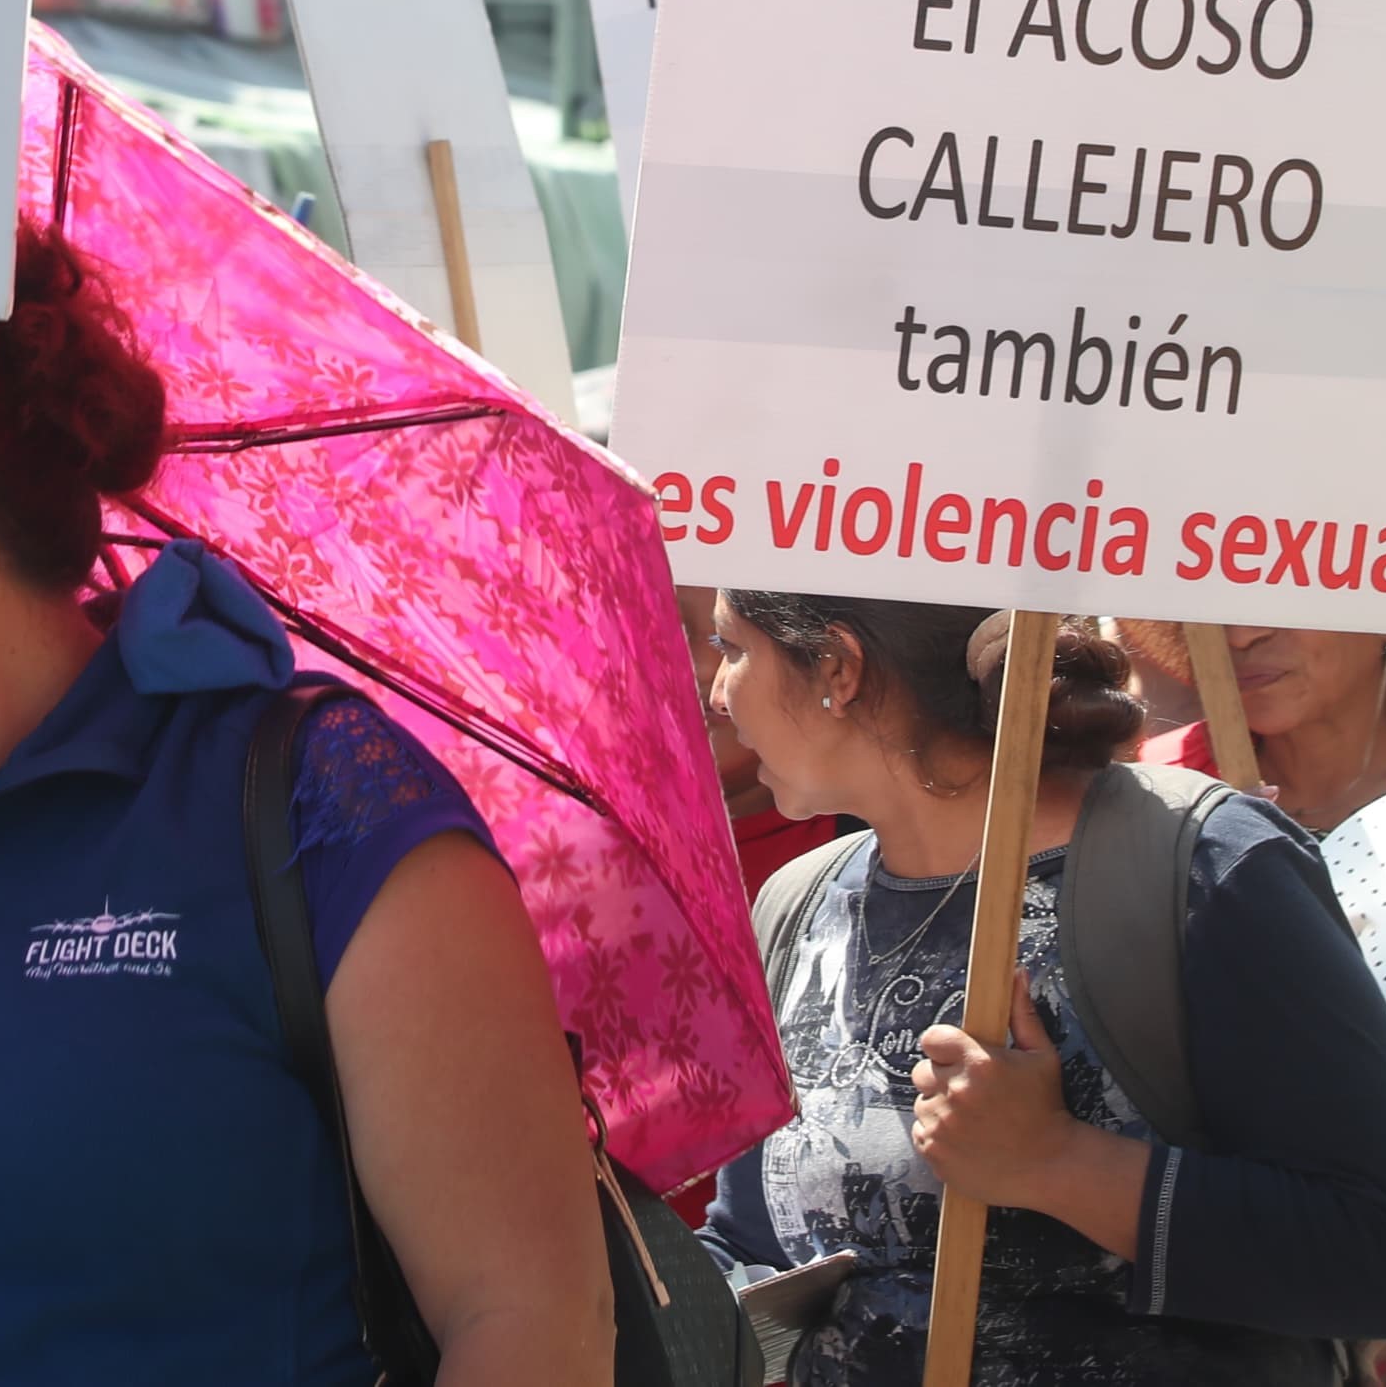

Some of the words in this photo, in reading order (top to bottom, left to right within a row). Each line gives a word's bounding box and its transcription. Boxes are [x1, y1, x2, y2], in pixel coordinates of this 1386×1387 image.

[857, 126, 1324, 251] CALLEJERO
[894, 304, 1243, 415] también
[654, 470, 736, 545] es
[765, 458, 1150, 577] violencia
[25, 935, 109, 964] FLIGHT
[114, 930, 177, 959] DECK
